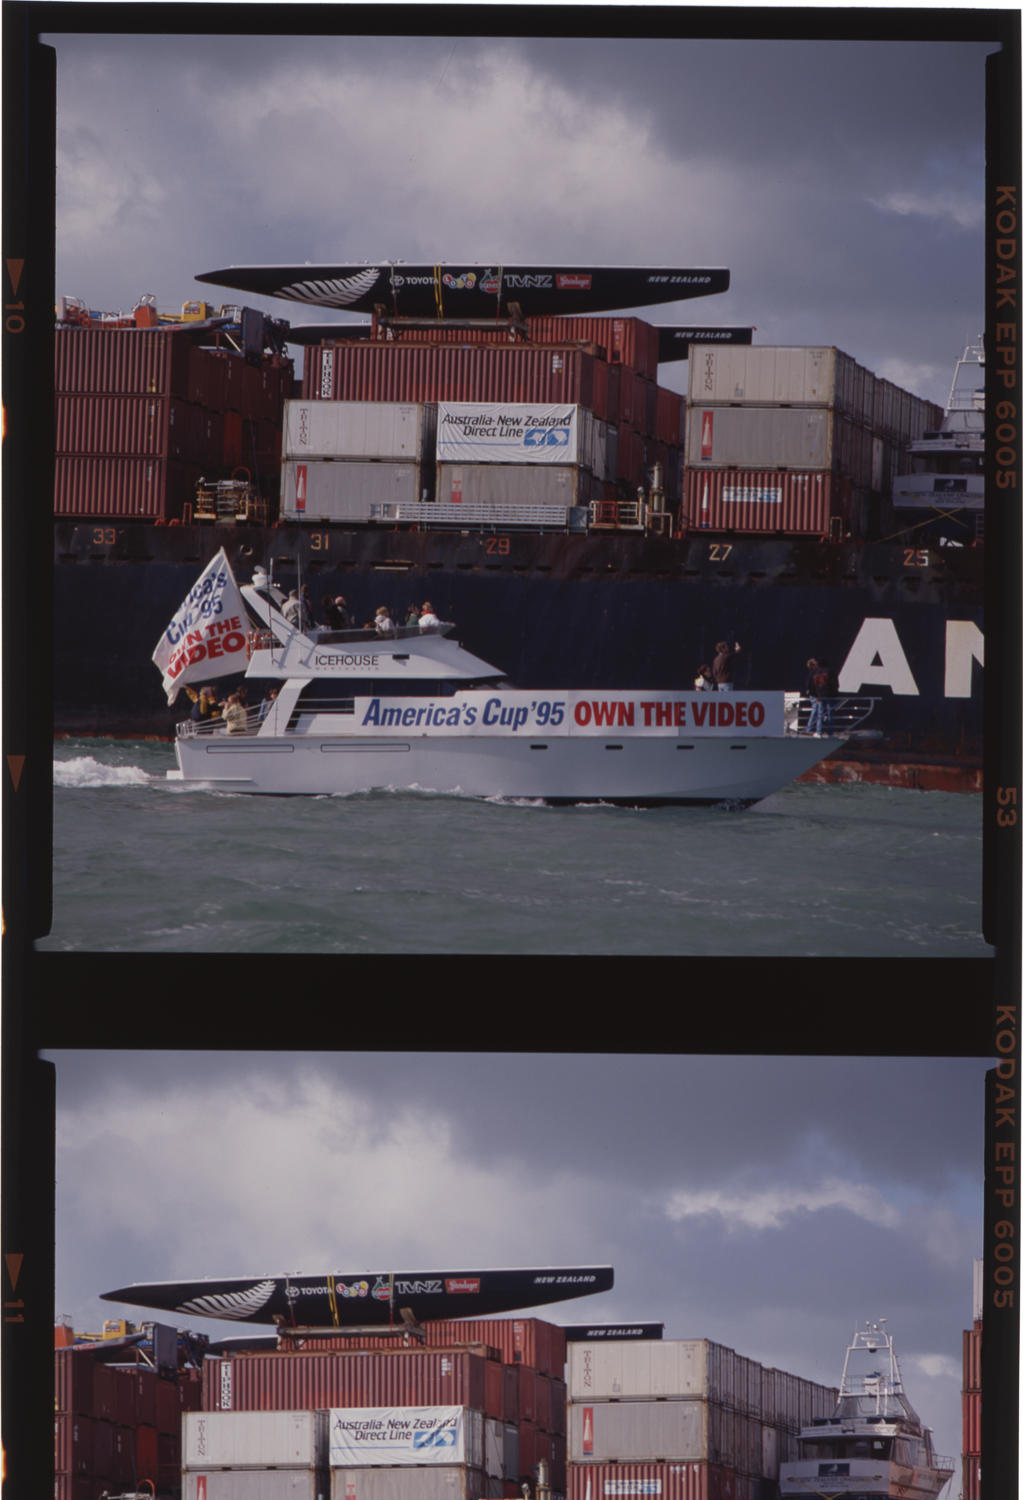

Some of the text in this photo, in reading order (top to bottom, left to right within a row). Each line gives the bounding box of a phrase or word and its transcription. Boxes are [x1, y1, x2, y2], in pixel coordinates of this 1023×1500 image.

[406, 277, 439, 286] TOYOTA
[503, 274, 553, 288] TVNZ
[6, 301, 24, 334] 10
[996, 186, 1016, 488] KODAK EPP 6005
[497, 415, 523, 426] New
[524, 415, 572, 427] Zealand
[463, 425, 524, 437] Direct Line
[92, 528, 117, 545] 33
[310, 533, 330, 551] 31
[485, 537, 511, 555] 29
[708, 544, 733, 561] 27
[903, 549, 929, 567] 25
[205, 616, 243, 638] THE
[167, 631, 247, 679] VIDEO
[315, 655, 380, 666] ICEHOUSE
[361, 697, 766, 732] America's Cup '95 OWN THE VIDEO
[996, 786, 1016, 827] 53
[994, 1005, 1016, 1307] KODAK EPP 6005
[395, 1280, 443, 1294] TVNZ
[534, 1275, 596, 1284] NEW ZEALAND
[300, 1286, 333, 1296] TOYOTA
[5, 1298, 24, 1323] 11
[387, 1418, 410, 1430] New
[412, 1417, 458, 1430] Zeald
[354, 1430, 412, 1441] Direct Line
